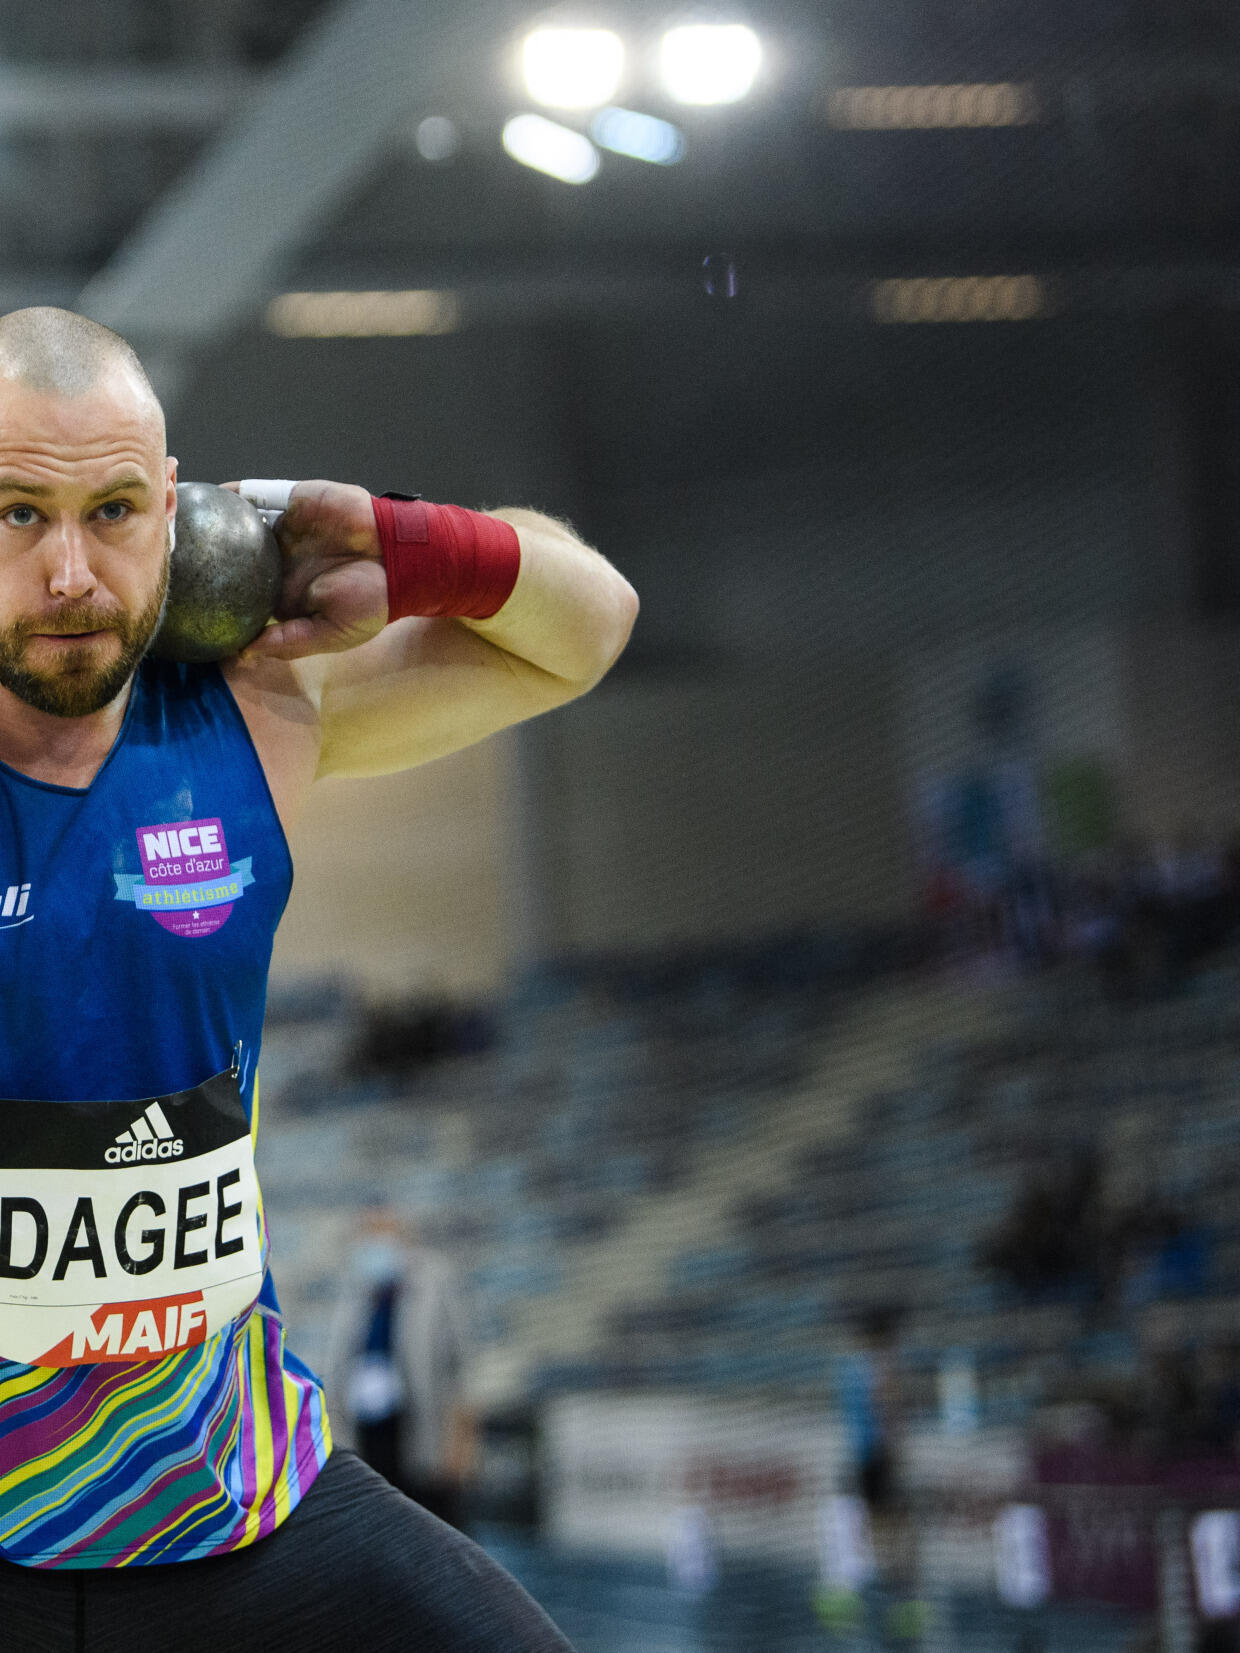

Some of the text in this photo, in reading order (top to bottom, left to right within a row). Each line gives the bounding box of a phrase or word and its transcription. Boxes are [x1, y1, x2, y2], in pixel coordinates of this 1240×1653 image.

[143, 825, 222, 861] NICE
[149, 858, 224, 878] côte d'azur
[143, 882, 239, 905] athlétisme
[104, 1138, 184, 1163] adidas
[71, 1303, 206, 1359] MAIF
